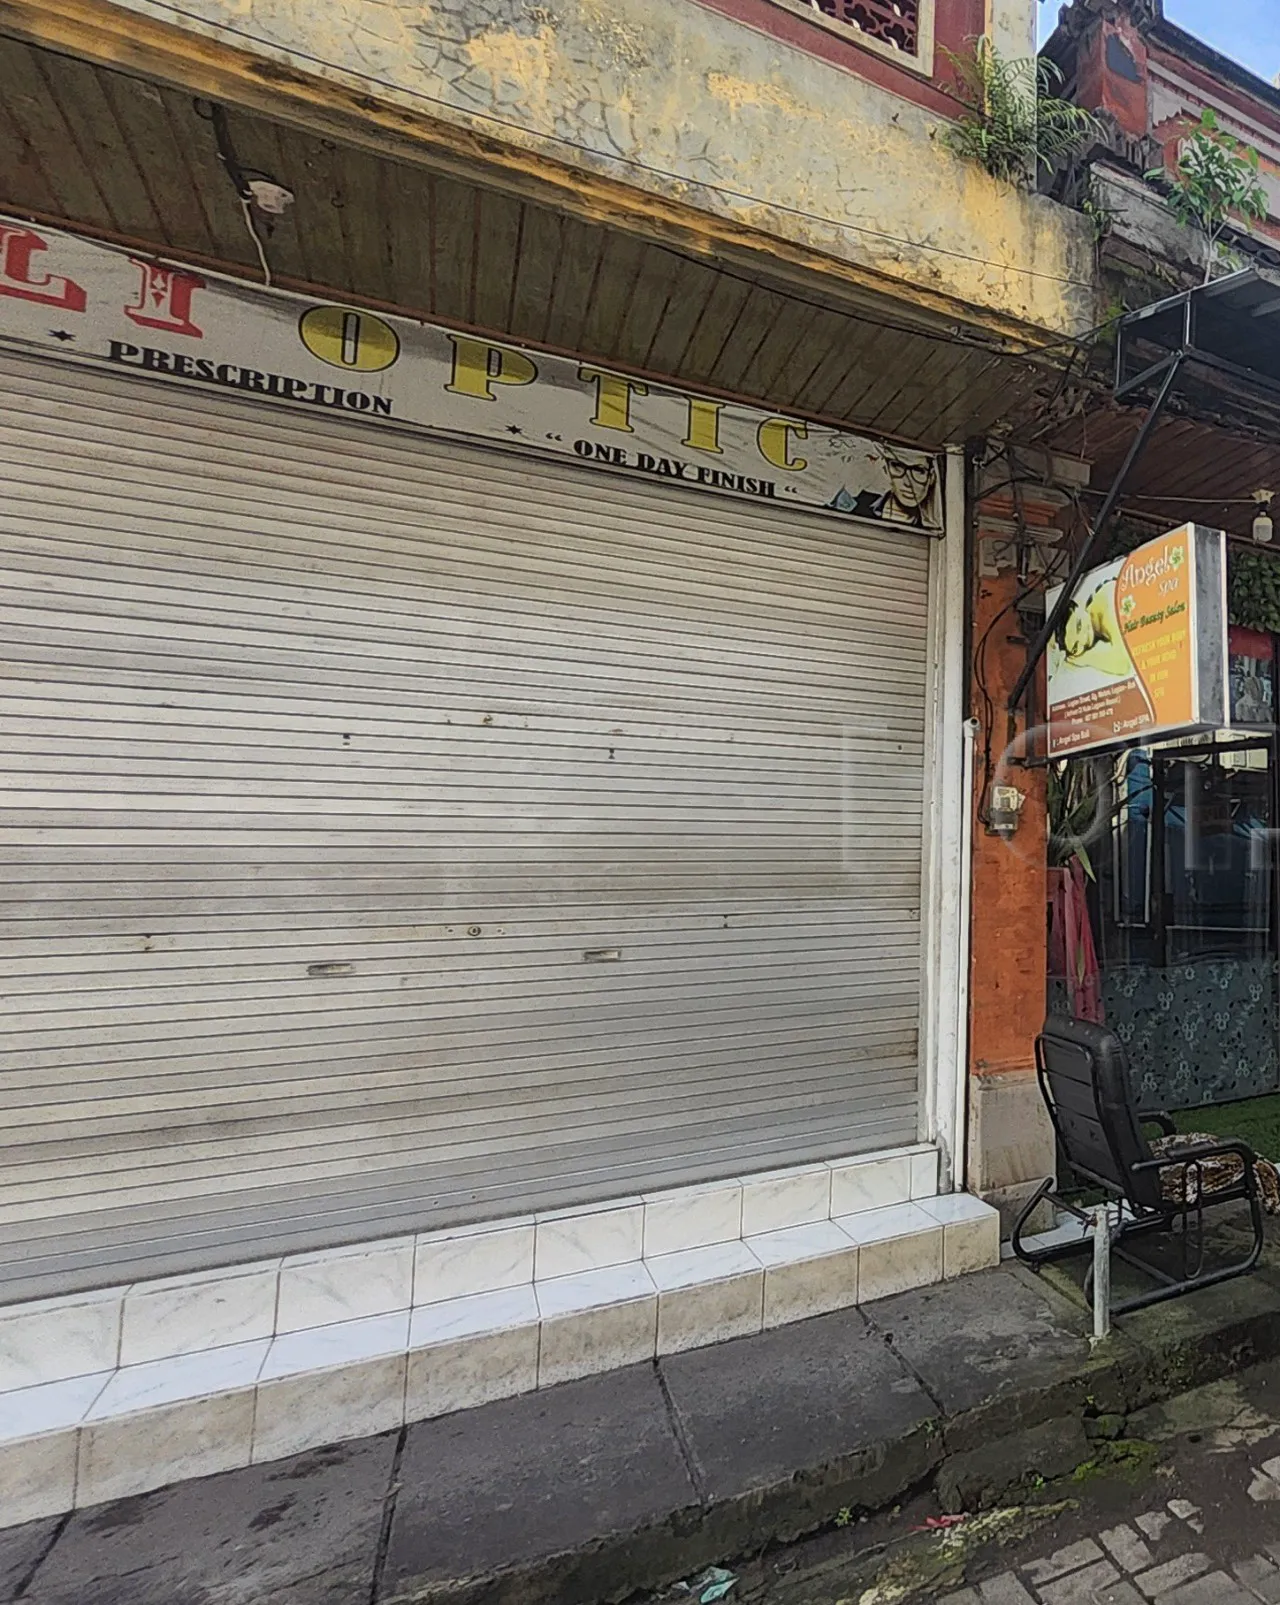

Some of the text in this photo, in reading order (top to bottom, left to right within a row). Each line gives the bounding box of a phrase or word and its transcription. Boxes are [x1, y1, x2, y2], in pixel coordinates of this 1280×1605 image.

[107, 339, 394, 416] PRESCRIPTION
[299, 304, 808, 471] OPTIC
[573, 438, 776, 498] ONE DAY FINISH
[1120, 545, 1170, 592] Angel
